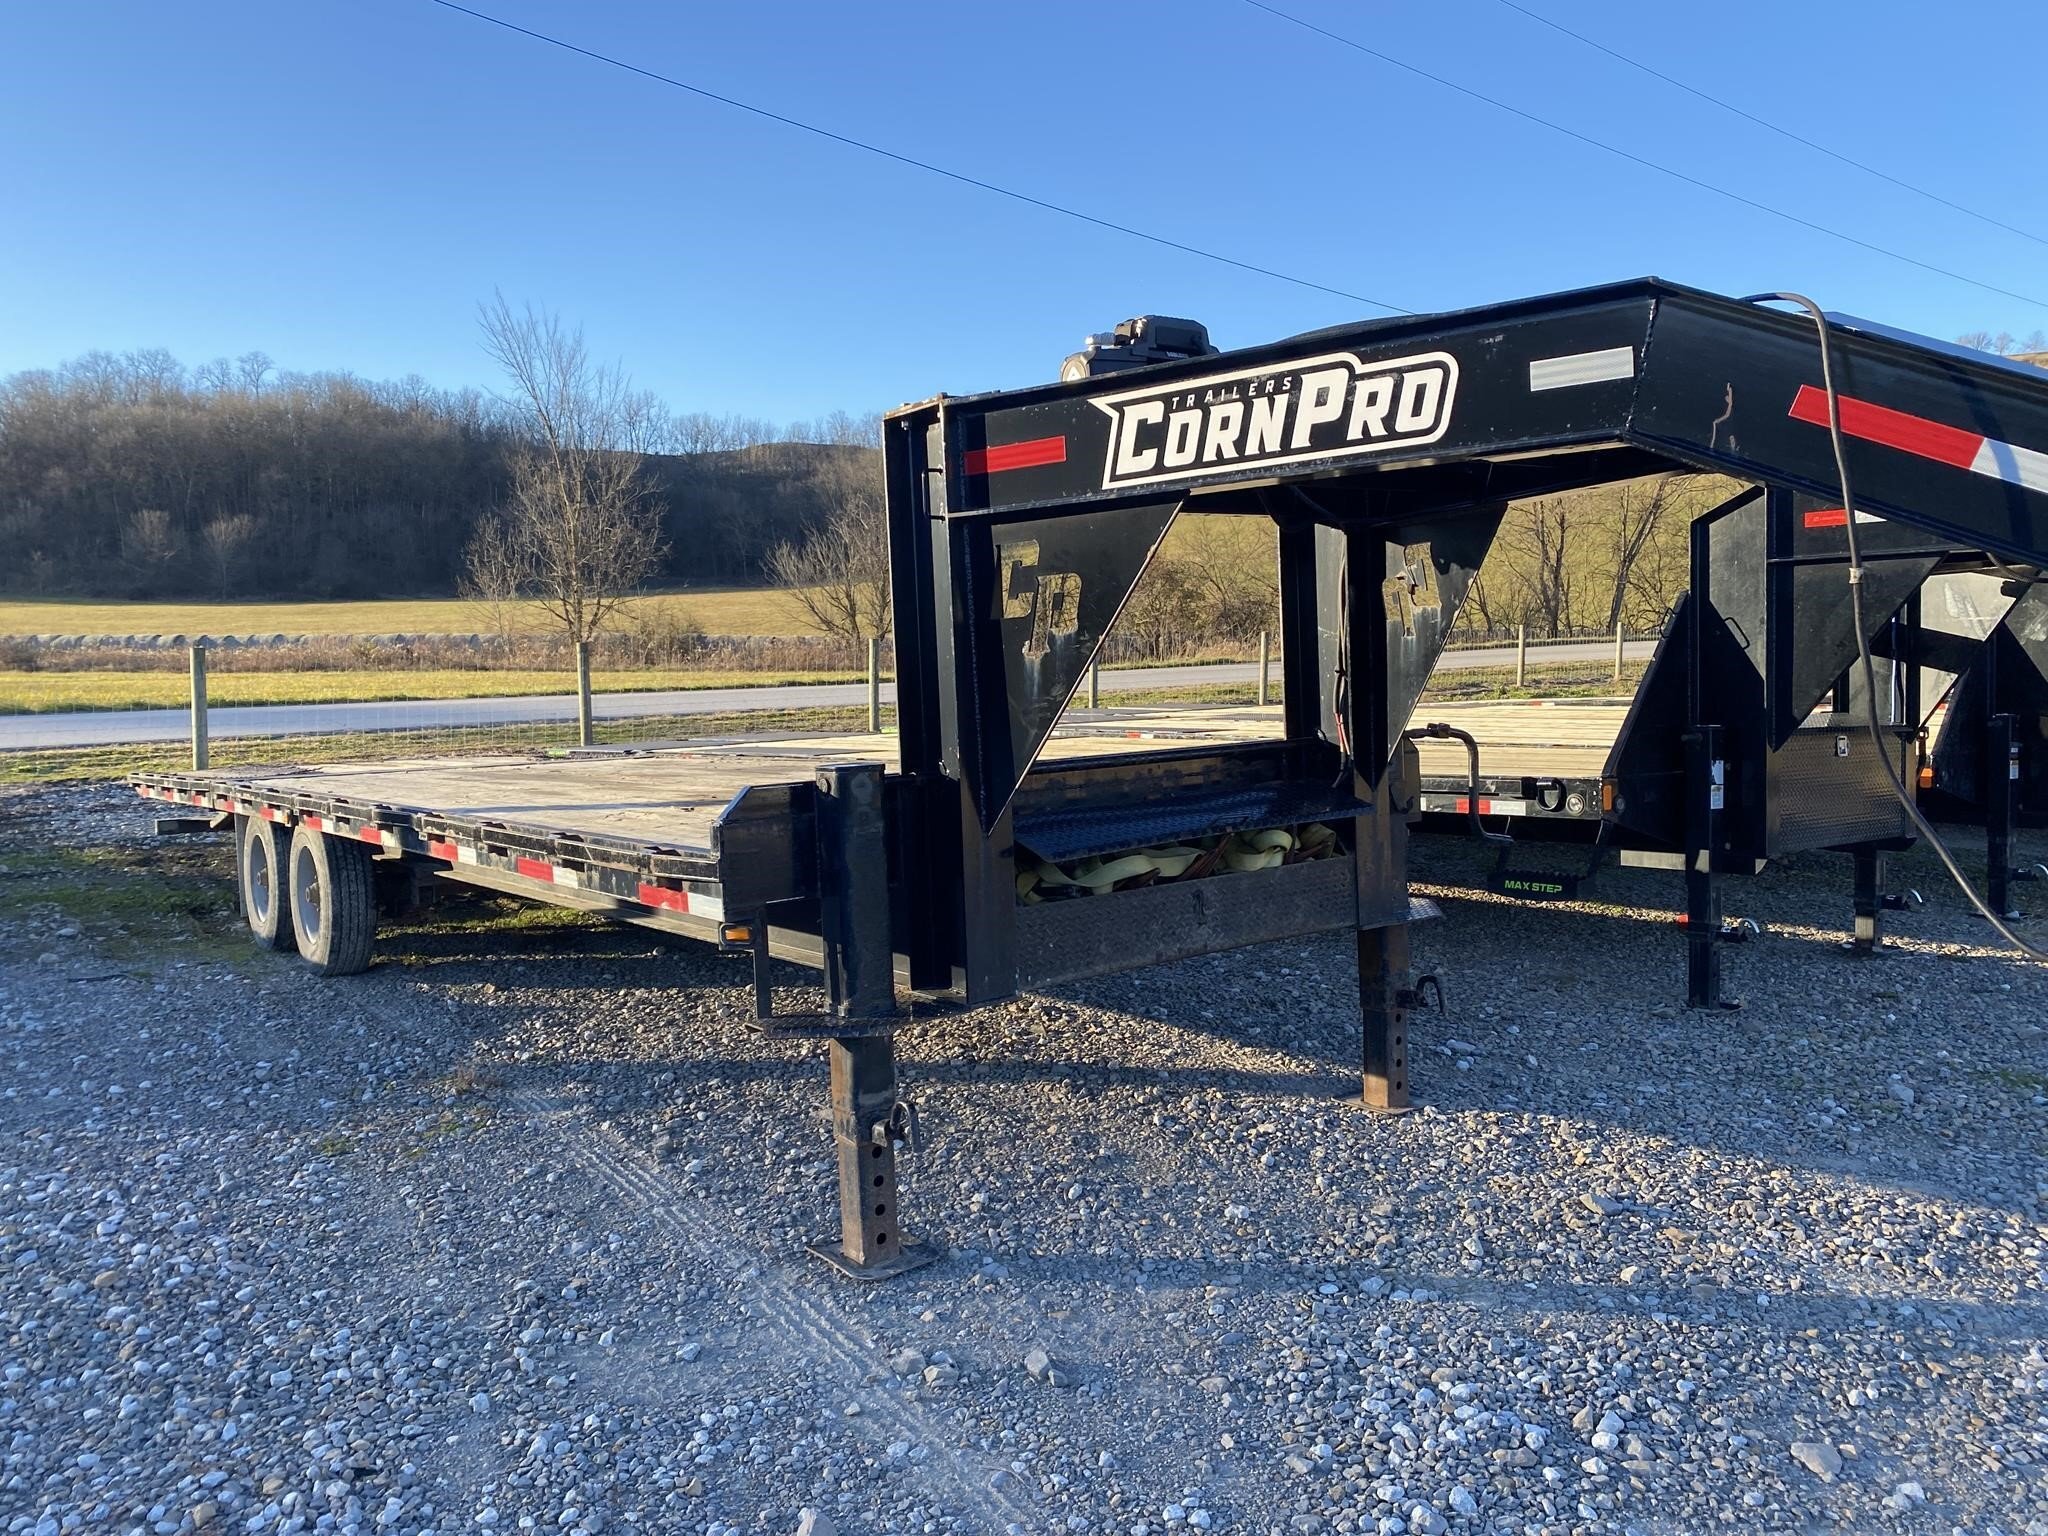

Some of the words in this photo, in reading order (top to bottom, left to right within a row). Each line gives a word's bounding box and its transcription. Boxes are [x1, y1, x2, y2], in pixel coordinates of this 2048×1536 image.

[1172, 376, 1292, 410] TRAILERS
[1504, 880, 1530, 891] MAX
[1531, 882, 1563, 894] STEP
